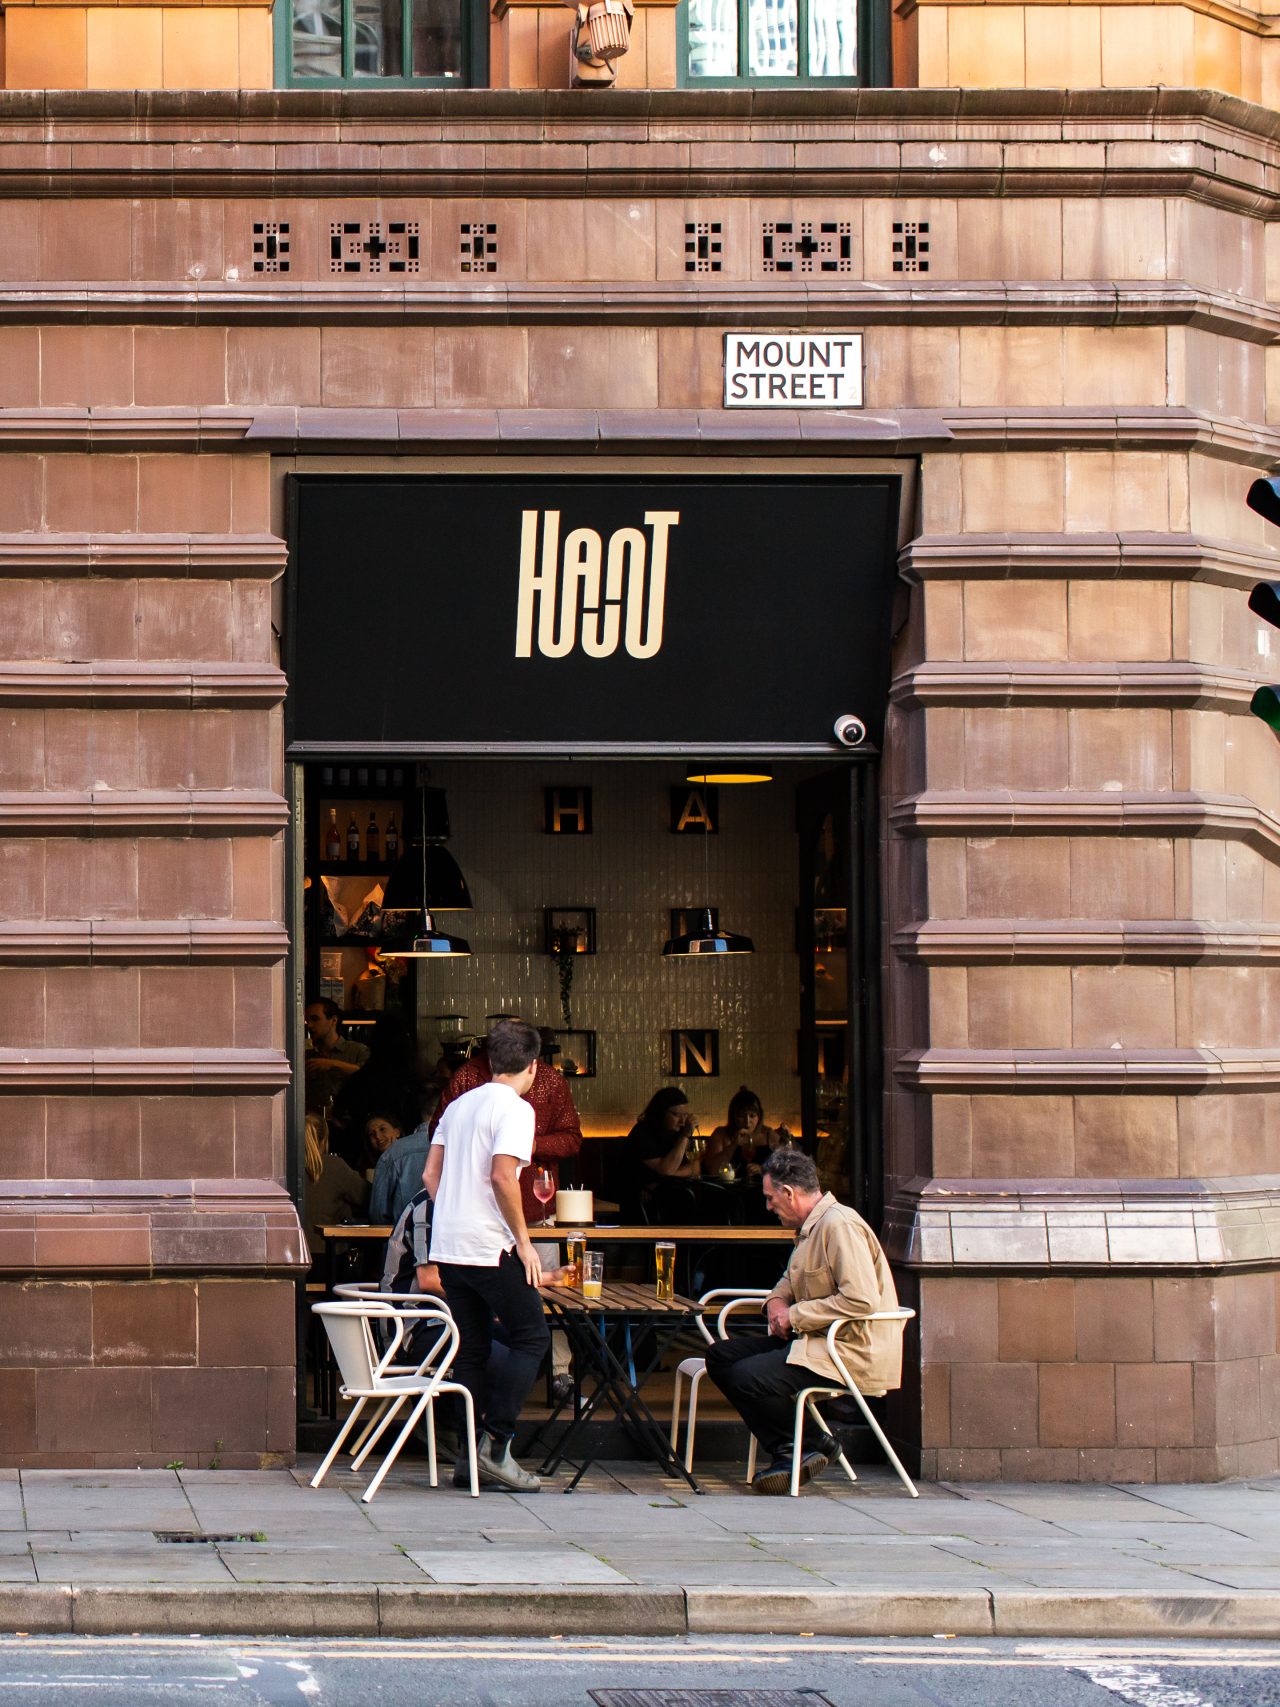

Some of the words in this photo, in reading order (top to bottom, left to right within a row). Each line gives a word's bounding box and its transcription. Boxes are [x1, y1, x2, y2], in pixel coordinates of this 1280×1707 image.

[736, 341, 853, 367] MOUNT
[730, 372, 845, 399] STREET
[848, 386, 858, 400] 2
[552, 791, 585, 832] H
[677, 791, 713, 832] A
[678, 1033, 713, 1074] N
